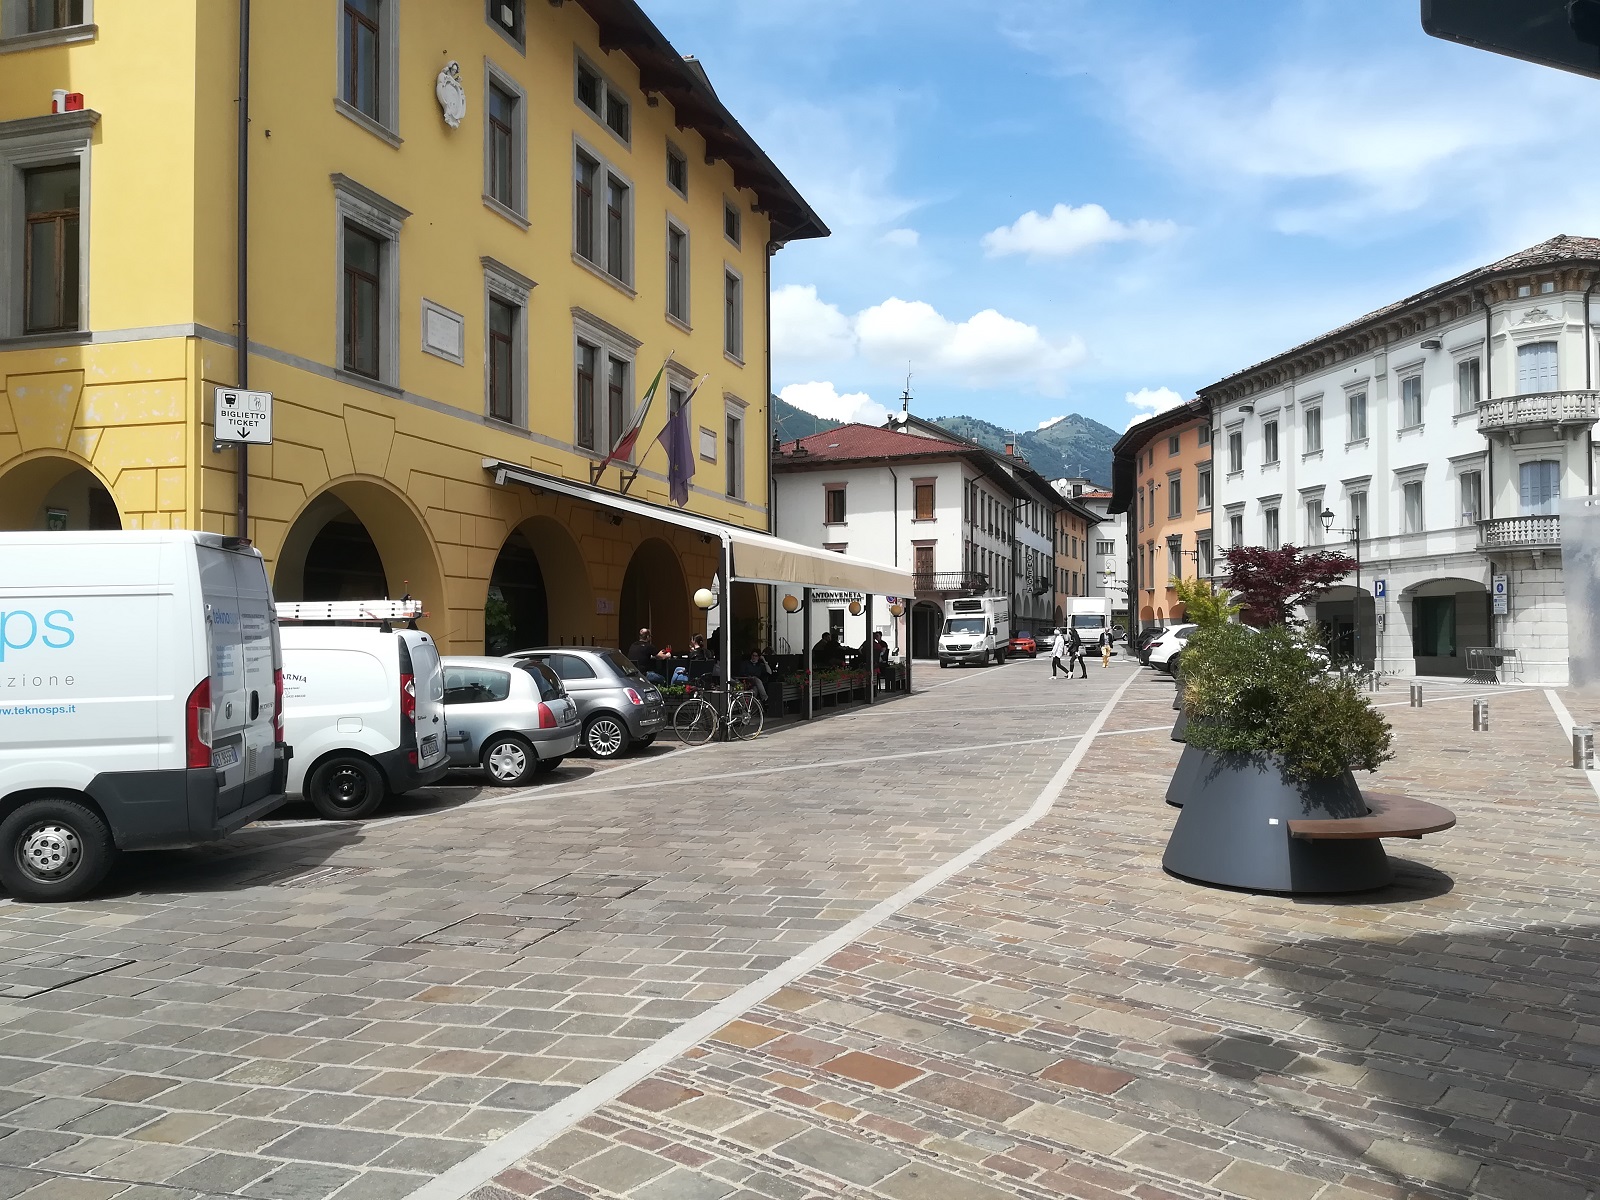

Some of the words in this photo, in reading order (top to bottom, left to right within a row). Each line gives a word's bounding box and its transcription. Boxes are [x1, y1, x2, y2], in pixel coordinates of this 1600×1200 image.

[221, 411, 266, 419] BIGLIETTO
[228, 419, 259, 427] TICKET
[1377, 581, 1383, 596] P
[812, 591, 861, 600] ANTONVENETA
[0, 609, 75, 662] ps
[0, 673, 75, 688] zione
